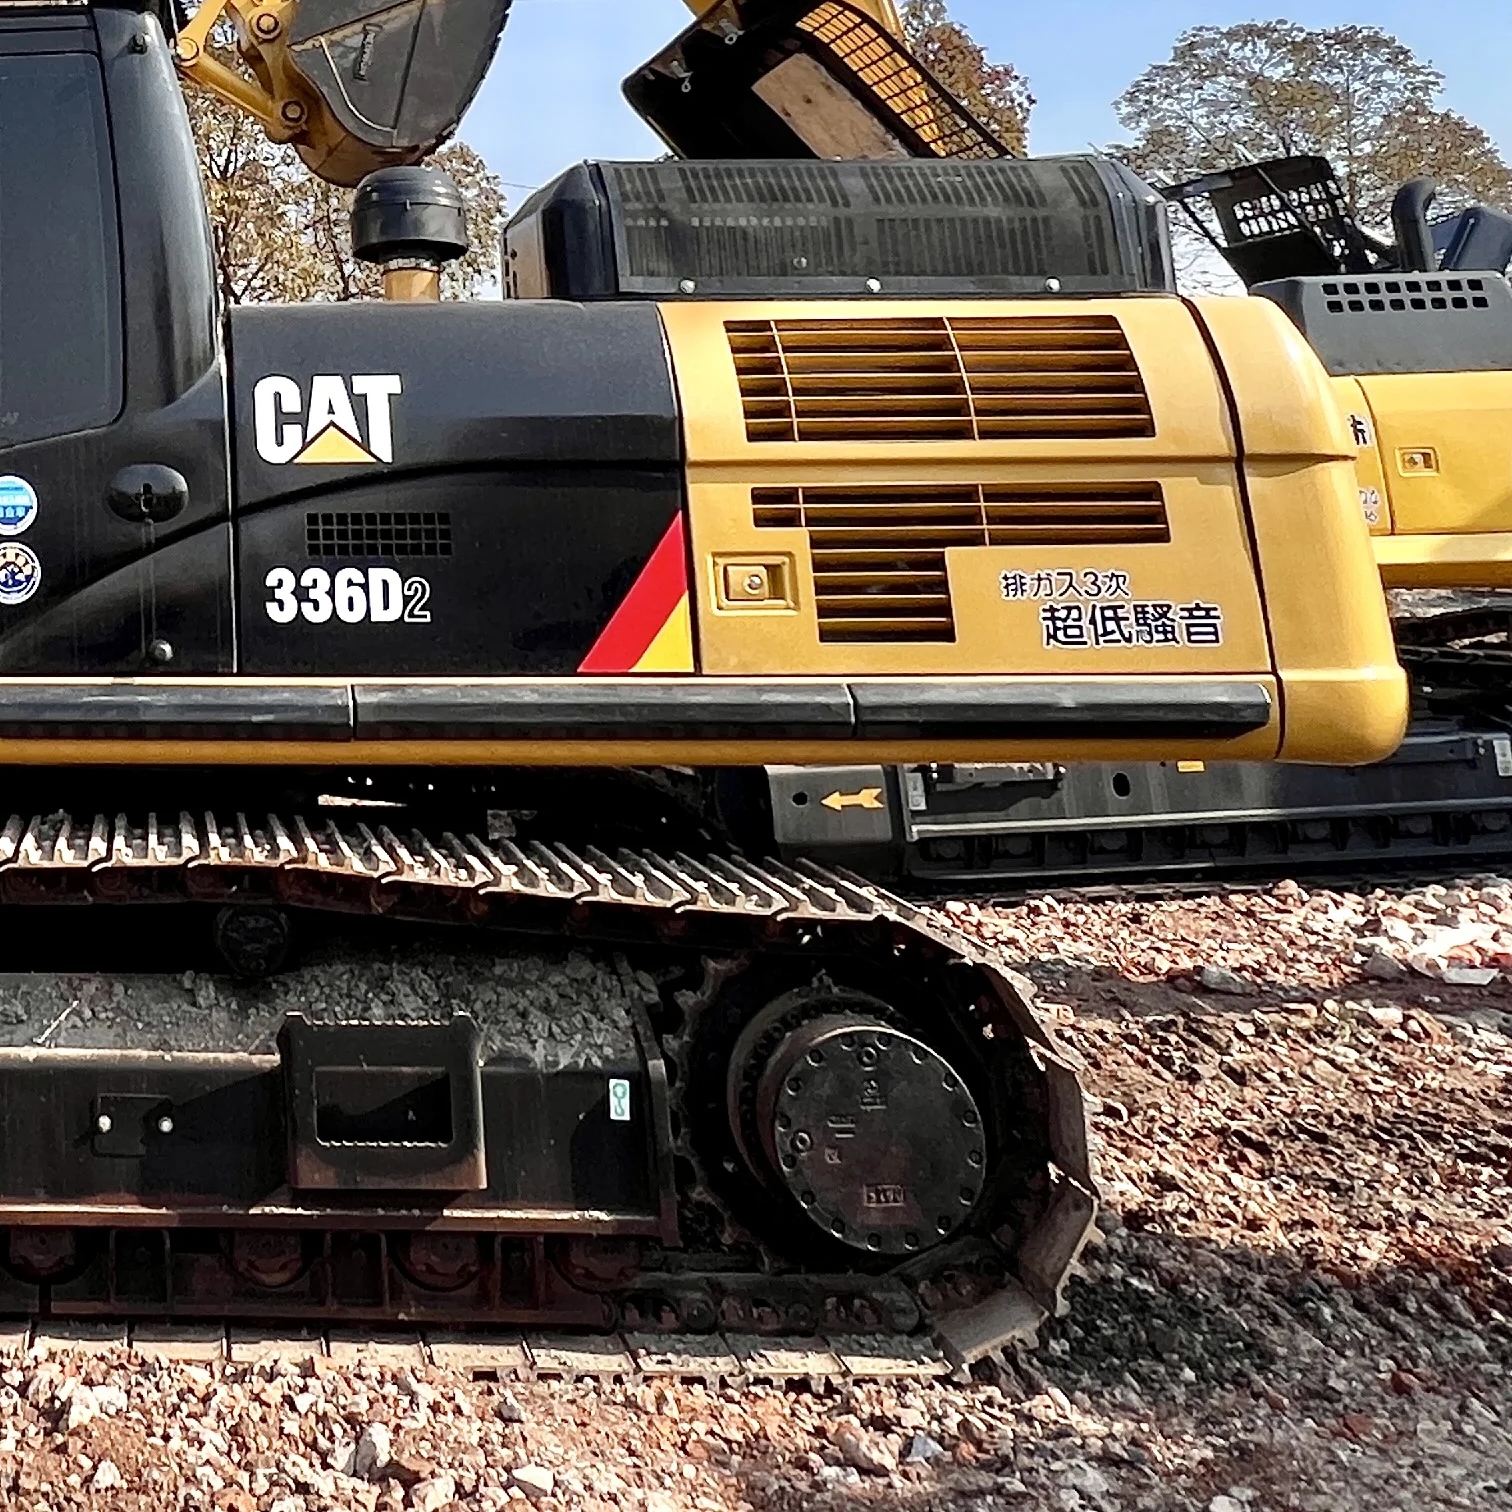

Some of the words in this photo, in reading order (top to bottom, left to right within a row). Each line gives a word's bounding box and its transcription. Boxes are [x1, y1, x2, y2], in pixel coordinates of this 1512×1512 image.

[253, 373, 403, 465] CAT
[264, 566, 432, 624] 336D2
[1001, 570, 1130, 598] 排ガス3次
